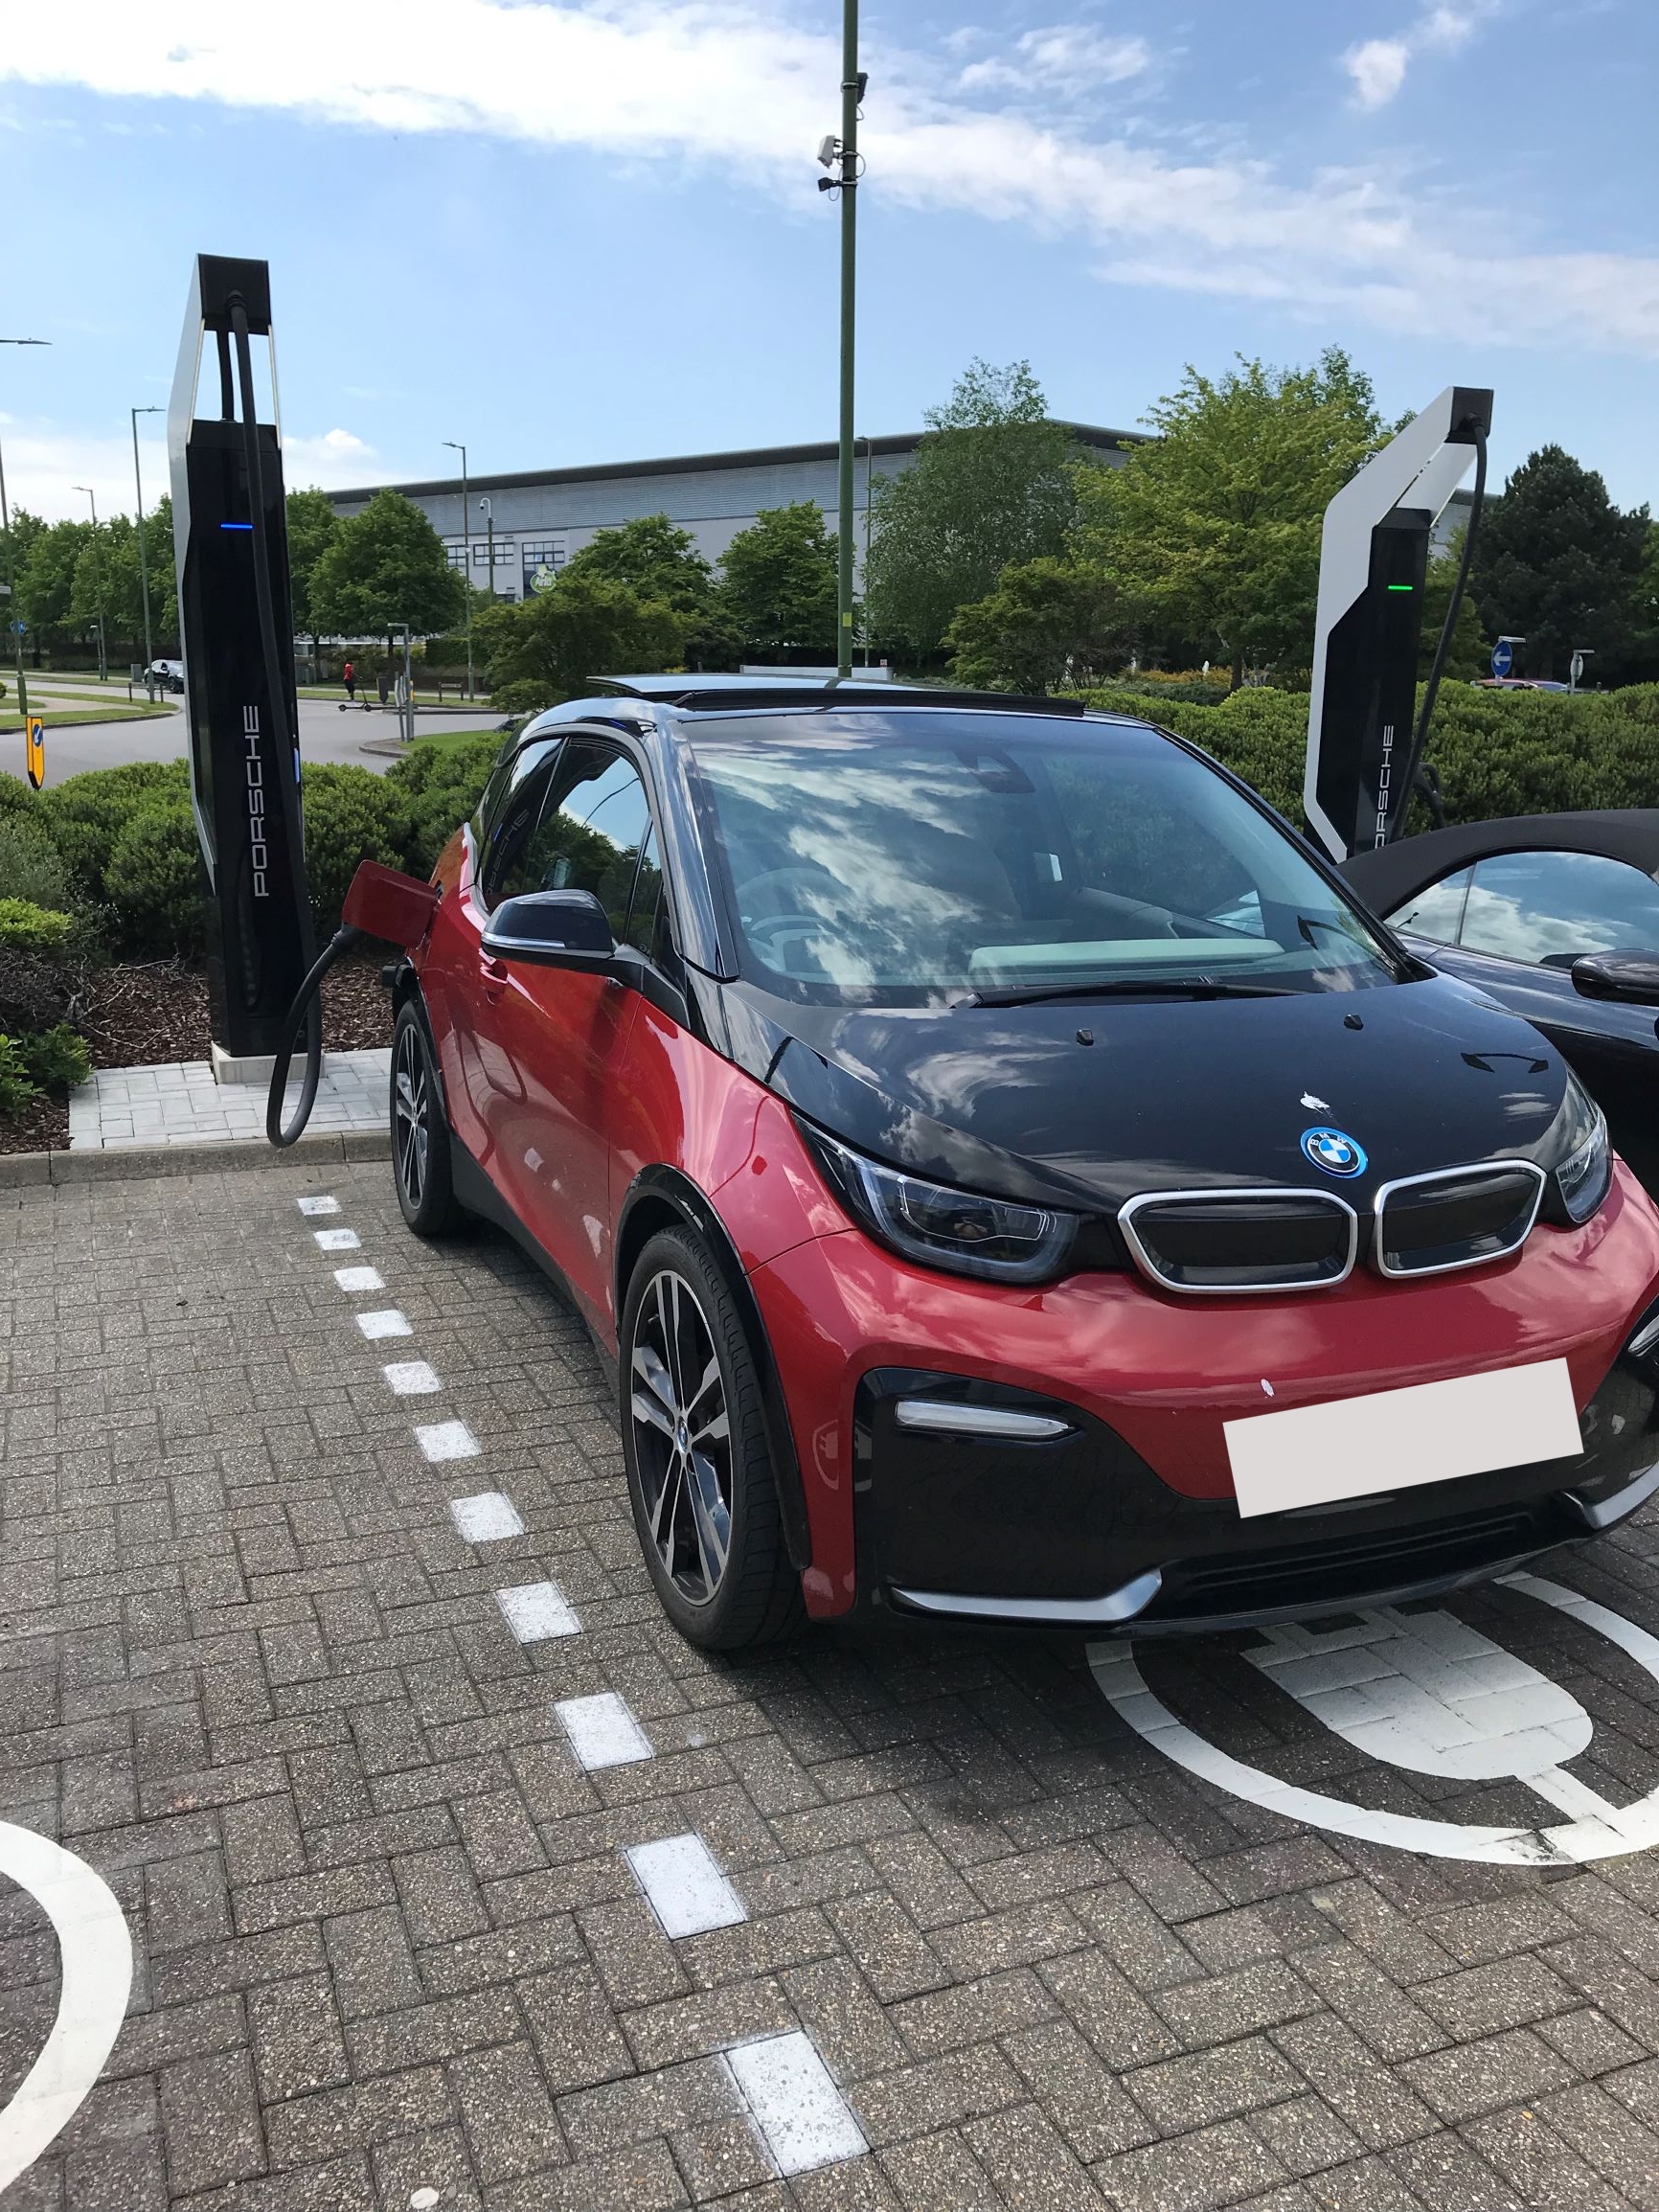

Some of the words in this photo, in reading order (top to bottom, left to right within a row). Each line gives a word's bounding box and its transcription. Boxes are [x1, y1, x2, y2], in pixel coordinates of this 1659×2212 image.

[242, 705, 270, 898] PORSCHE
[1375, 725, 1395, 850] ORSCHE
[1309, 1132, 1348, 1147] BMW
